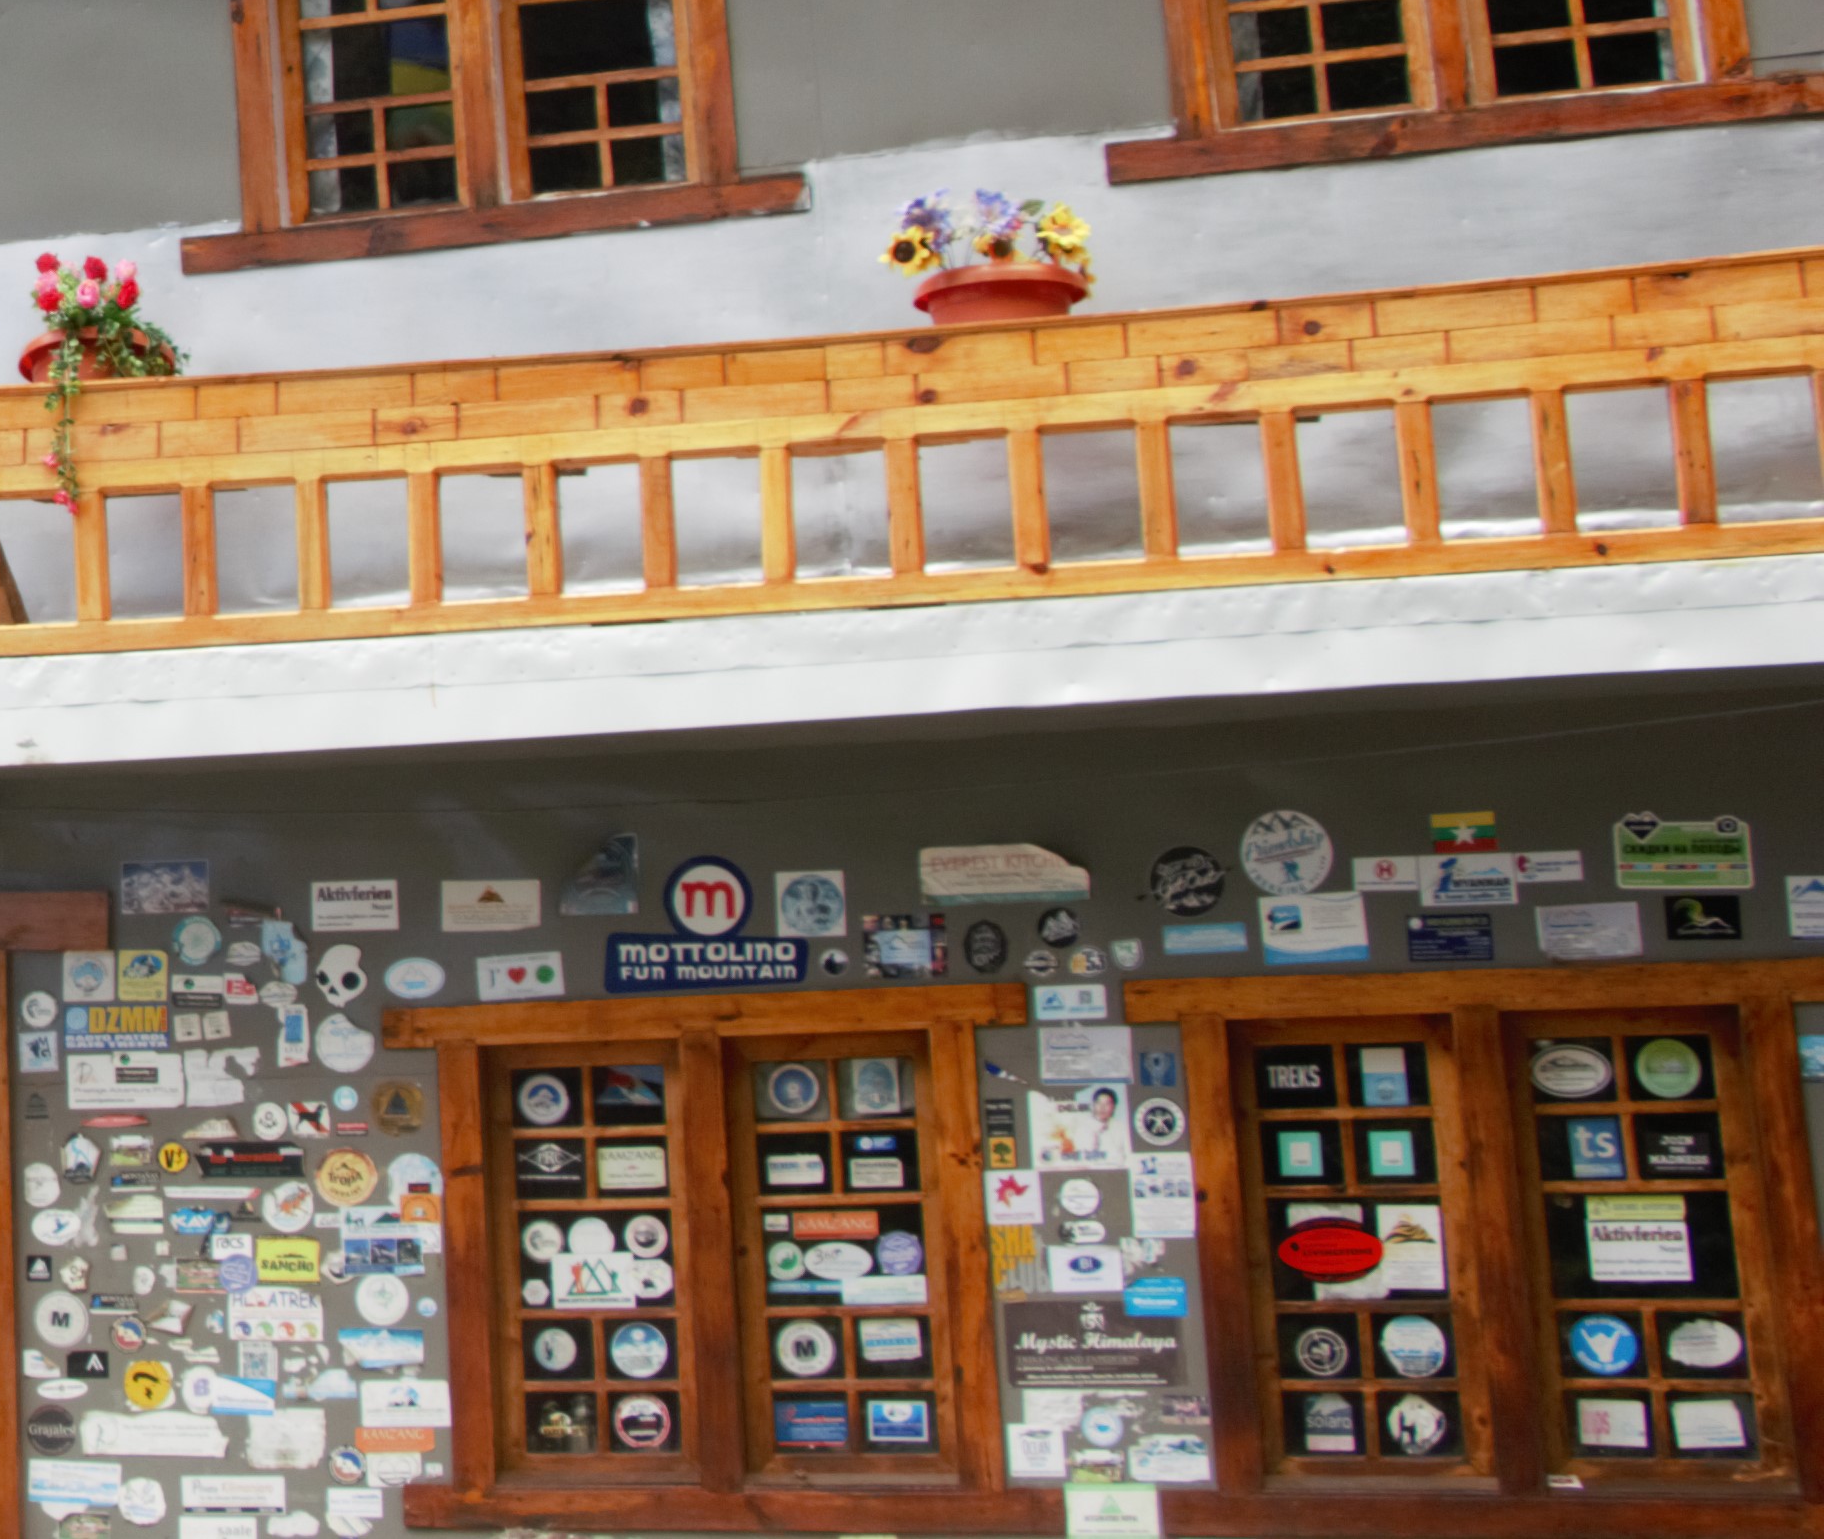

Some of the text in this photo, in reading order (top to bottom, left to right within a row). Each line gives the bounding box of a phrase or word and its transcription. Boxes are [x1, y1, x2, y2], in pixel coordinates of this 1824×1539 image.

[316, 885, 393, 903] Aktivferien
[618, 942, 797, 964] MOTTOLINO
[620, 963, 797, 981] FUN MOUNTAIN
[89, 1005, 163, 1034] DZMM
[1267, 1065, 1322, 1089] TREKS
[1574, 1124, 1617, 1160] ts
[797, 1217, 875, 1230] KAMZANG
[1591, 1225, 1684, 1243] Aktivferien
[260, 1259, 315, 1273] SANCHO
[1014, 1330, 1179, 1355] Mystic Himalaya
